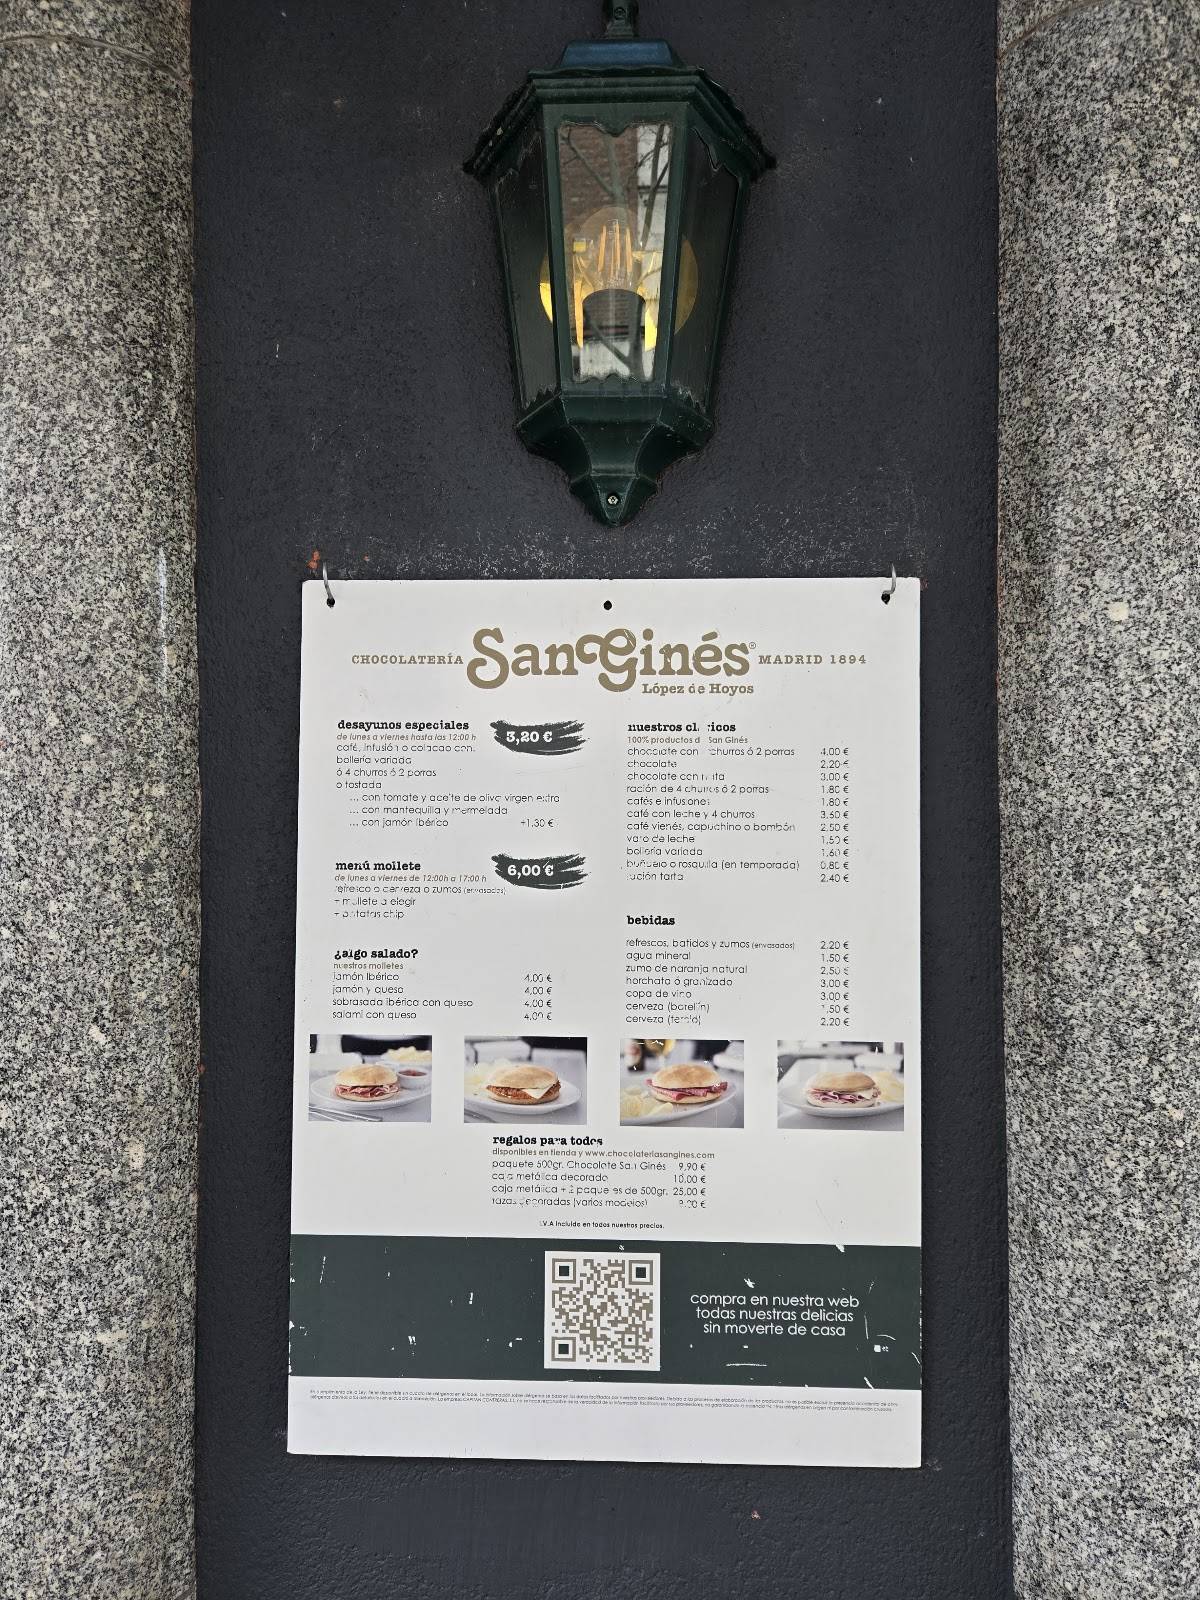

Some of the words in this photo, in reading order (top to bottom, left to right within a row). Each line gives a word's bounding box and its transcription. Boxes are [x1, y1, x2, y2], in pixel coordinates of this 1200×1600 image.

[352, 653, 464, 665] CHOCOLATERÍA
[466, 627, 578, 690] San
[575, 628, 751, 693] Ginés
[758, 654, 822, 664] MADRID
[830, 654, 866, 664] 1894
[642, 682, 684, 696] López
[688, 683, 706, 694] de
[708, 683, 754, 696] Hoyos
[338, 720, 402, 732] desayunos
[405, 720, 469, 732] especiales
[628, 722, 682, 732] nuestros
[686, 722, 736, 732] clicos
[336, 732, 348, 740] de
[349, 733, 370, 742] lunes
[380, 733, 409, 741] viernes
[410, 733, 434, 741] hasta
[434, 733, 446, 741] las
[449, 733, 470, 741] 12:00
[506, 731, 539, 744] 3,20
[542, 731, 552, 742] €
[650, 736, 693, 744] productos
[680, 748, 699, 756] con
[755, 747, 762, 756] 2
[764, 749, 795, 758] porras
[345, 768, 351, 776] 4
[353, 768, 388, 777] churros
[626, 772, 677, 781] chocolate
[345, 780, 382, 789] tostada
[660, 785, 674, 793] de
[739, 785, 770, 795] porras
[362, 794, 380, 802] con
[383, 793, 418, 802] tomate
[463, 794, 477, 802] de
[626, 808, 649, 818] café
[720, 809, 755, 819] churros
[361, 819, 380, 827] con
[547, 818, 554, 828] €
[626, 821, 649, 830] café
[335, 860, 370, 870] menú
[721, 860, 737, 871] (en
[740, 860, 800, 871] temporada)
[508, 864, 541, 877] 6,00
[543, 864, 554, 876] €
[334, 873, 346, 882] de
[347, 874, 368, 882] lunes
[370, 873, 376, 882] a
[377, 874, 408, 882] viernes
[409, 874, 420, 882] de
[432, 886, 462, 894] zumos
[626, 915, 675, 925] bebidas
[672, 939, 710, 948] batidos
[370, 948, 418, 958] salado?
[626, 952, 652, 962] agua
[656, 951, 690, 960] mineral
[670, 964, 709, 974] naranja
[626, 976, 671, 985] horchata
[626, 990, 652, 999] copa
[655, 989, 668, 998] de
[422, 999, 441, 1007] con
[626, 1003, 664, 1011] cerveza
[366, 1009, 386, 1019] con
[492, 1135, 537, 1146] regalos
[492, 1148, 537, 1156] disponibles
[624, 1187, 638, 1195] de
[690, 1295, 746, 1308] compra
[750, 1296, 768, 1306] en
[773, 1294, 824, 1309] nuestra
[827, 1294, 859, 1308] web
[696, 1306, 736, 1321] todas
[740, 1308, 797, 1322] nuestras
[801, 1309, 854, 1322] delicias
[704, 1321, 721, 1334] sin
[725, 1322, 784, 1334] moverte
[788, 1322, 807, 1335] de
[811, 1326, 846, 1336] casa
